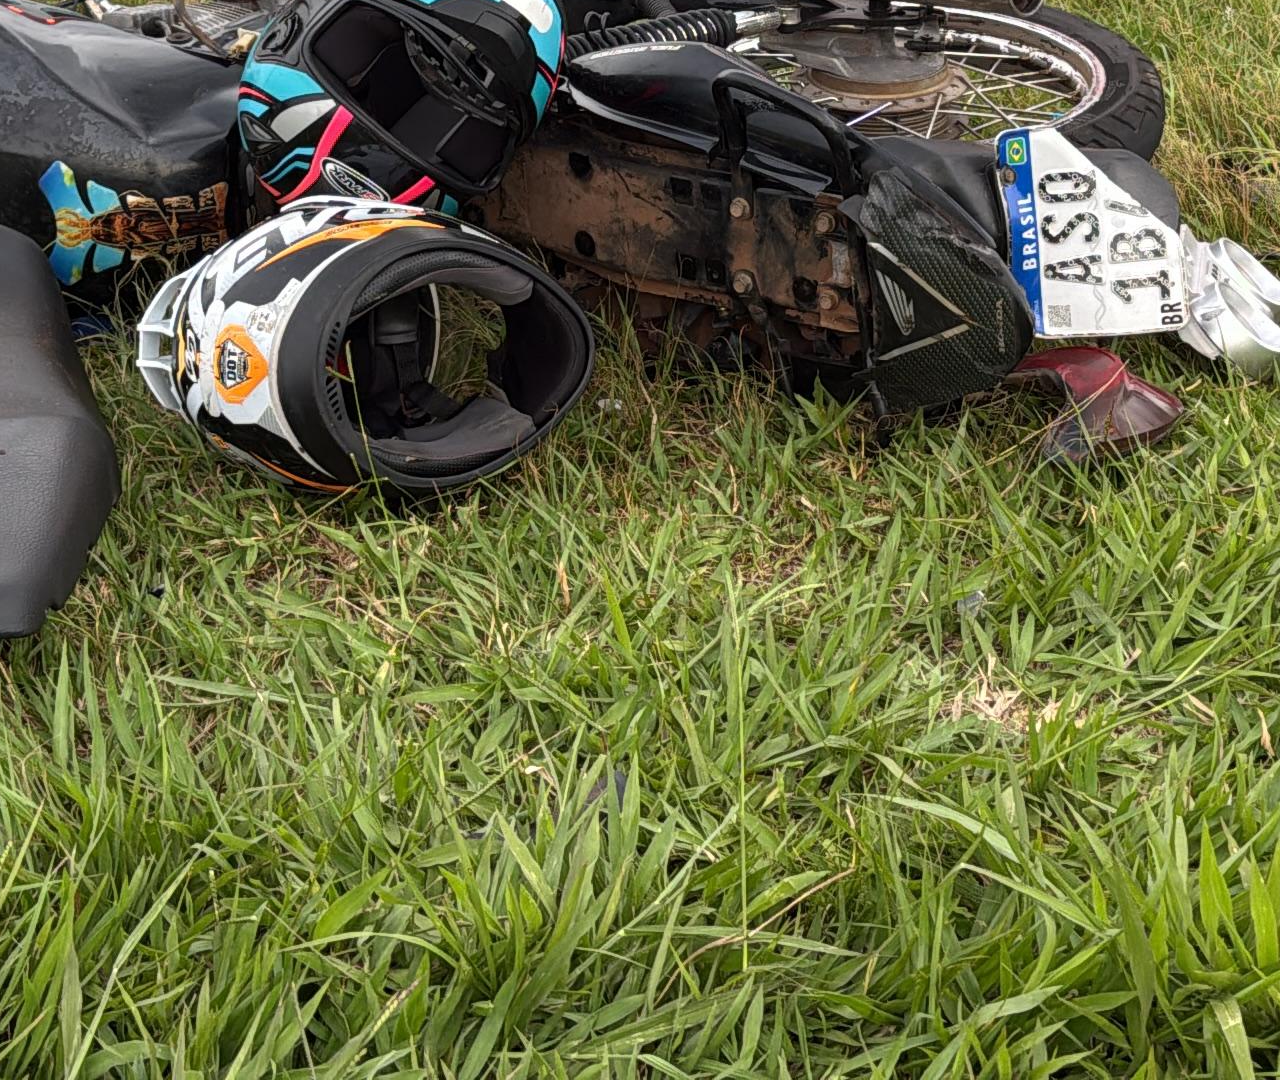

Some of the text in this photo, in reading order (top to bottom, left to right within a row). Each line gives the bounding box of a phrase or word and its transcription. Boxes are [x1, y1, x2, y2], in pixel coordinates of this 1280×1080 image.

[1021, 193, 1038, 271] BRASIL
[1160, 301, 1184, 326] BR
[226, 349, 238, 382] DOT
